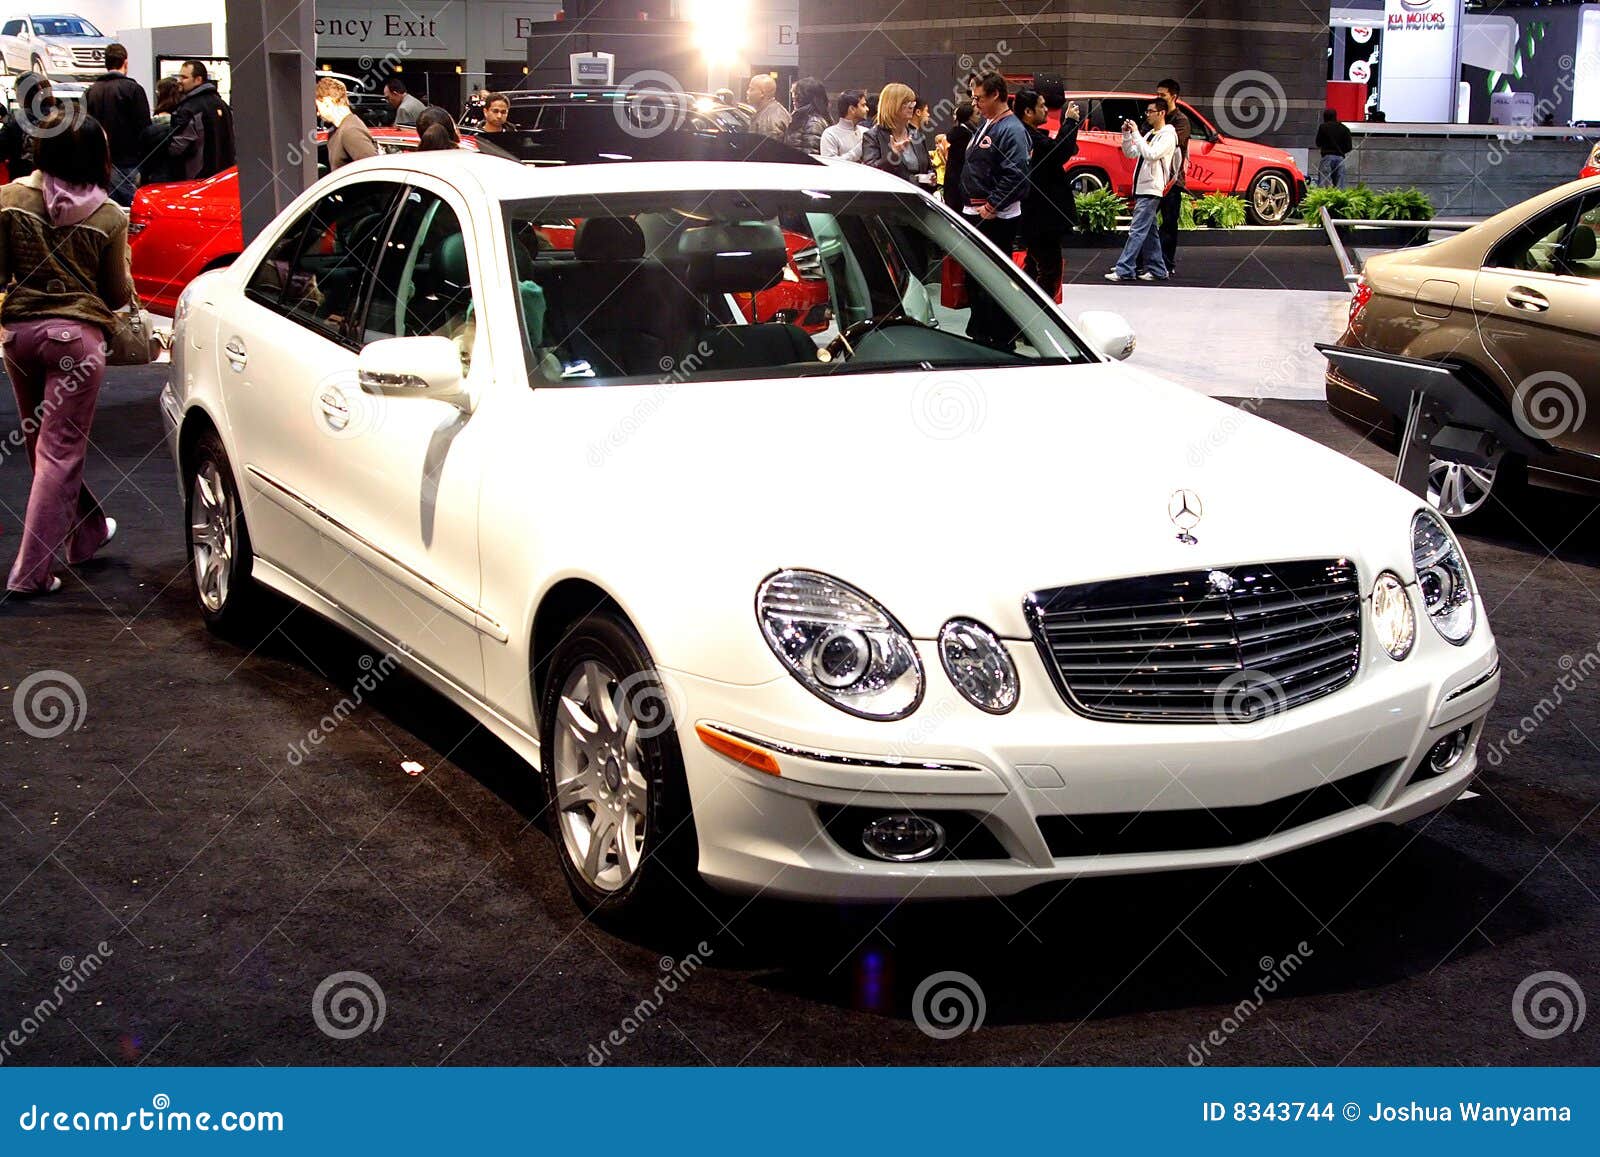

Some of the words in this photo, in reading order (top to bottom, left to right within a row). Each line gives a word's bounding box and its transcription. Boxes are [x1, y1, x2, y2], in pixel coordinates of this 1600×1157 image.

[384, 14, 436, 37] Exit
[1387, 13, 1403, 23] KIA
[1406, 12, 1445, 23] MOTORS
